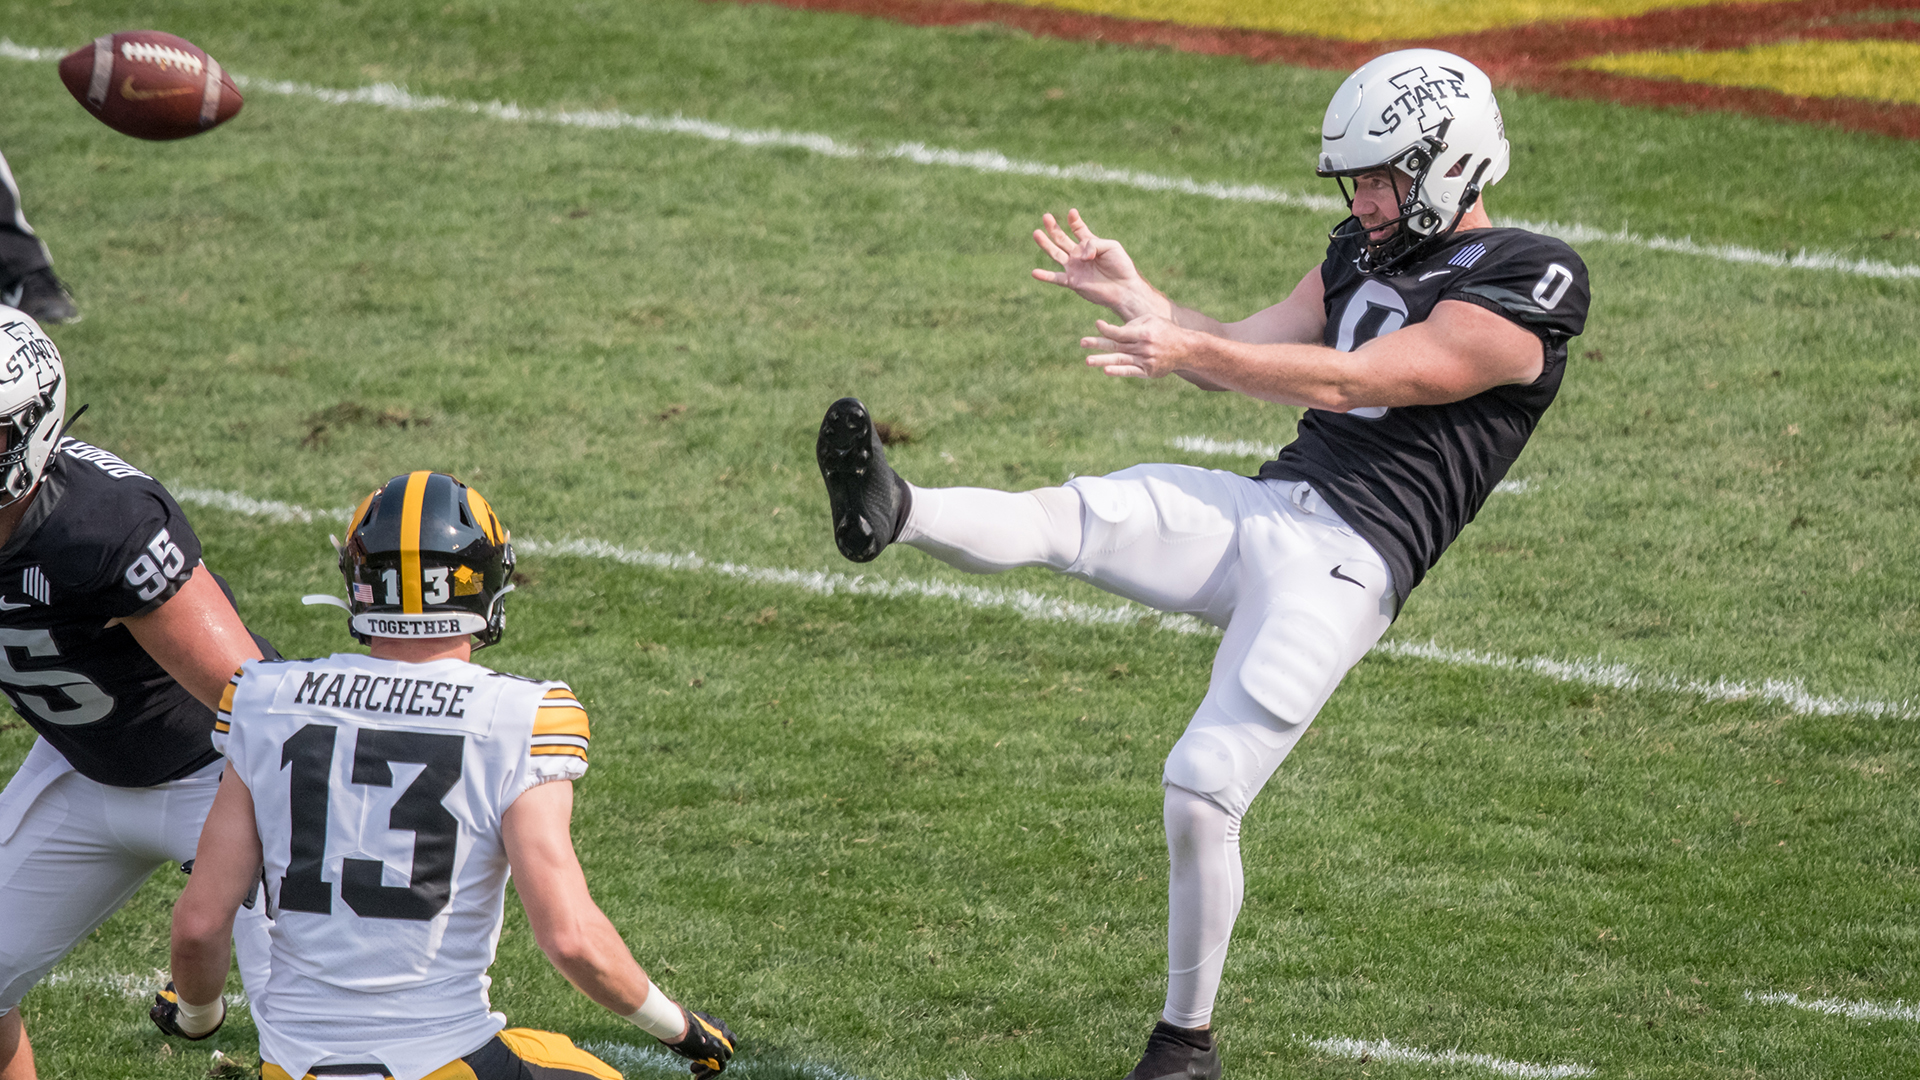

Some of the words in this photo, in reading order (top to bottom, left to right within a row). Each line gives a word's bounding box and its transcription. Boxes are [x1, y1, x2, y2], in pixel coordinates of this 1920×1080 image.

[1380, 78, 1470, 134] STATE
[1532, 263, 1574, 310] 0
[125, 527, 185, 601] 95
[367, 618, 462, 635] TOGETHER
[294, 671, 474, 719] MARCHESE
[278, 723, 466, 922] 13
